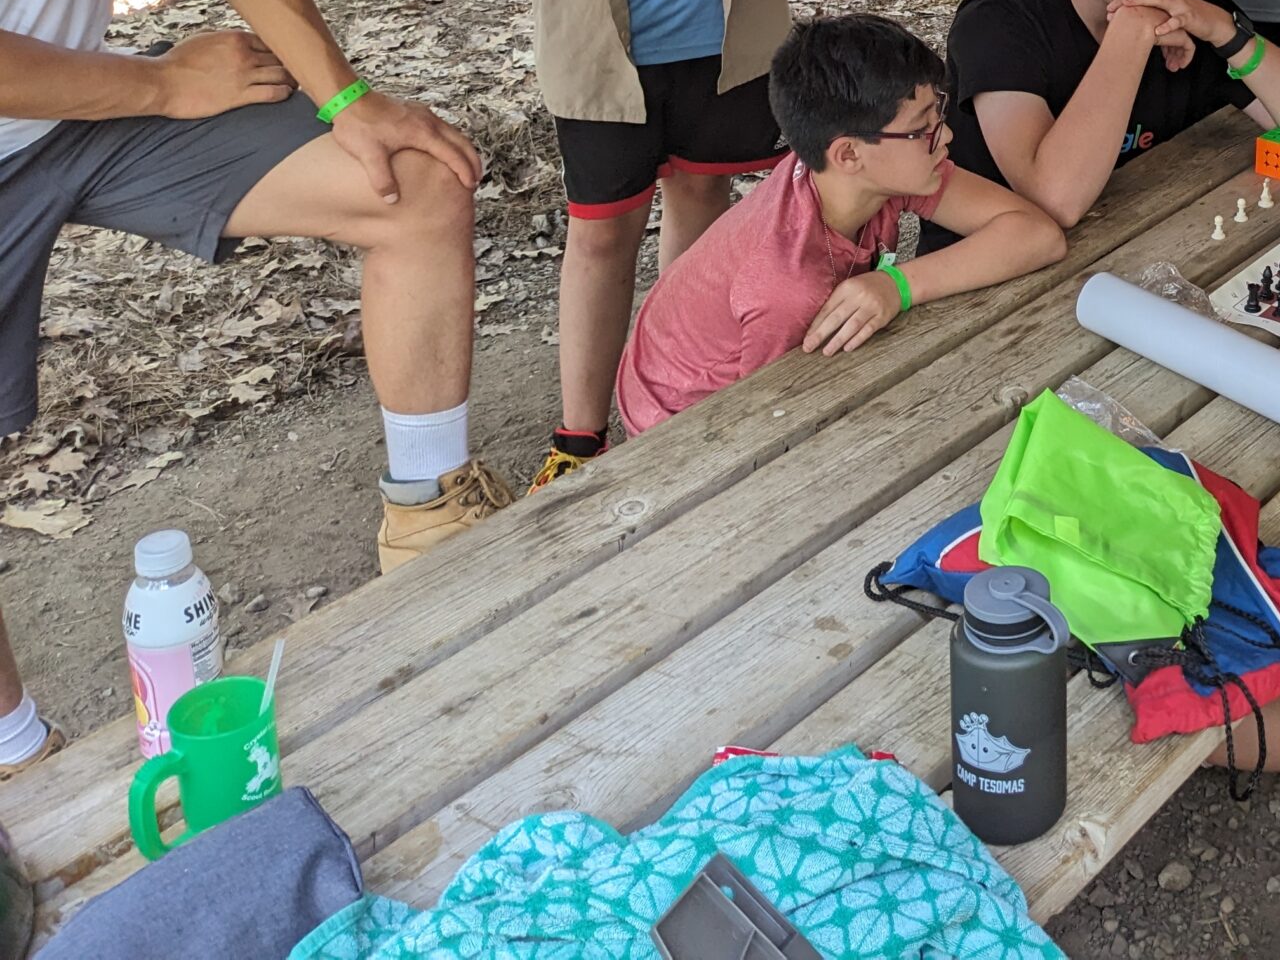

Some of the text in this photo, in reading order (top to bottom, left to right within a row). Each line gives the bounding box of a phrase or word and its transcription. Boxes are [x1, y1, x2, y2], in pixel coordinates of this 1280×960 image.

[1119, 123, 1154, 153] gle
[183, 588, 217, 624] SHIN
[956, 762, 1026, 794] CAMP TESOMAS
